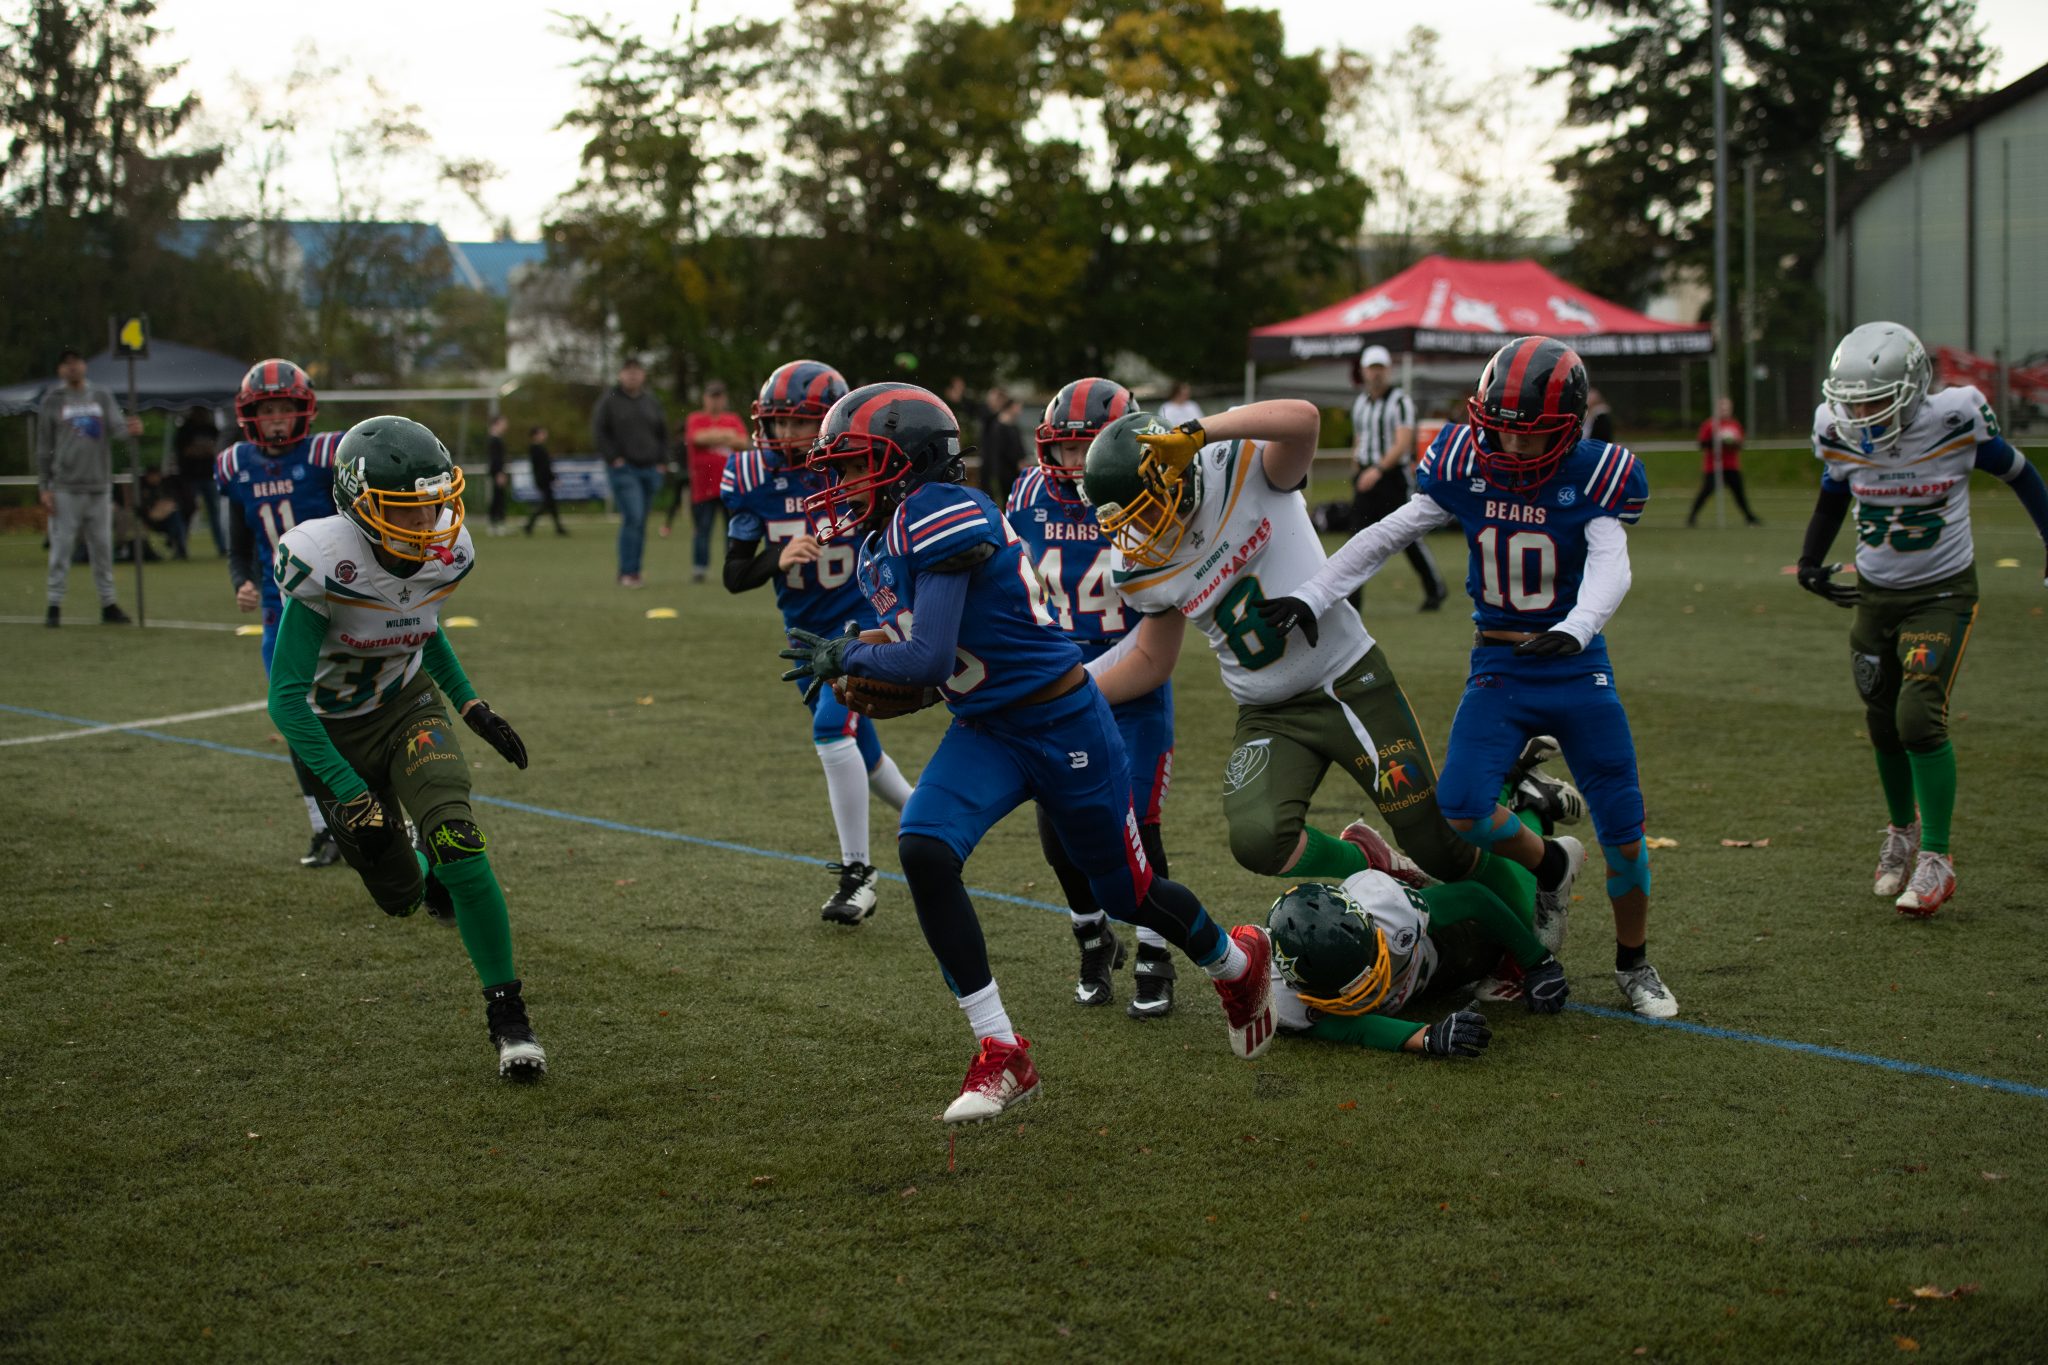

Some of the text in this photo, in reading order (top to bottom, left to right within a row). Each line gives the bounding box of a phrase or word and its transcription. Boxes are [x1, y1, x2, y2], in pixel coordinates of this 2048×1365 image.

[120, 318, 144, 350] 4
[253, 479, 294, 498] BEARS
[1485, 500, 1547, 525] BEARS
[1045, 523, 1099, 540] BEARS
[767, 517, 856, 590] 76
[1194, 540, 1230, 580] WILDBOYS
[1221, 517, 1272, 579] KAPPES
[274, 543, 313, 592] 37
[1476, 524, 1558, 612] 10
[1037, 547, 1126, 632] 44
[386, 617, 421, 629] WILDBOYS
[340, 634, 402, 649] GERÜSTBAU
[1355, 738, 1416, 769] PhsioFit
[1084, 937, 1102, 950] NIKE
